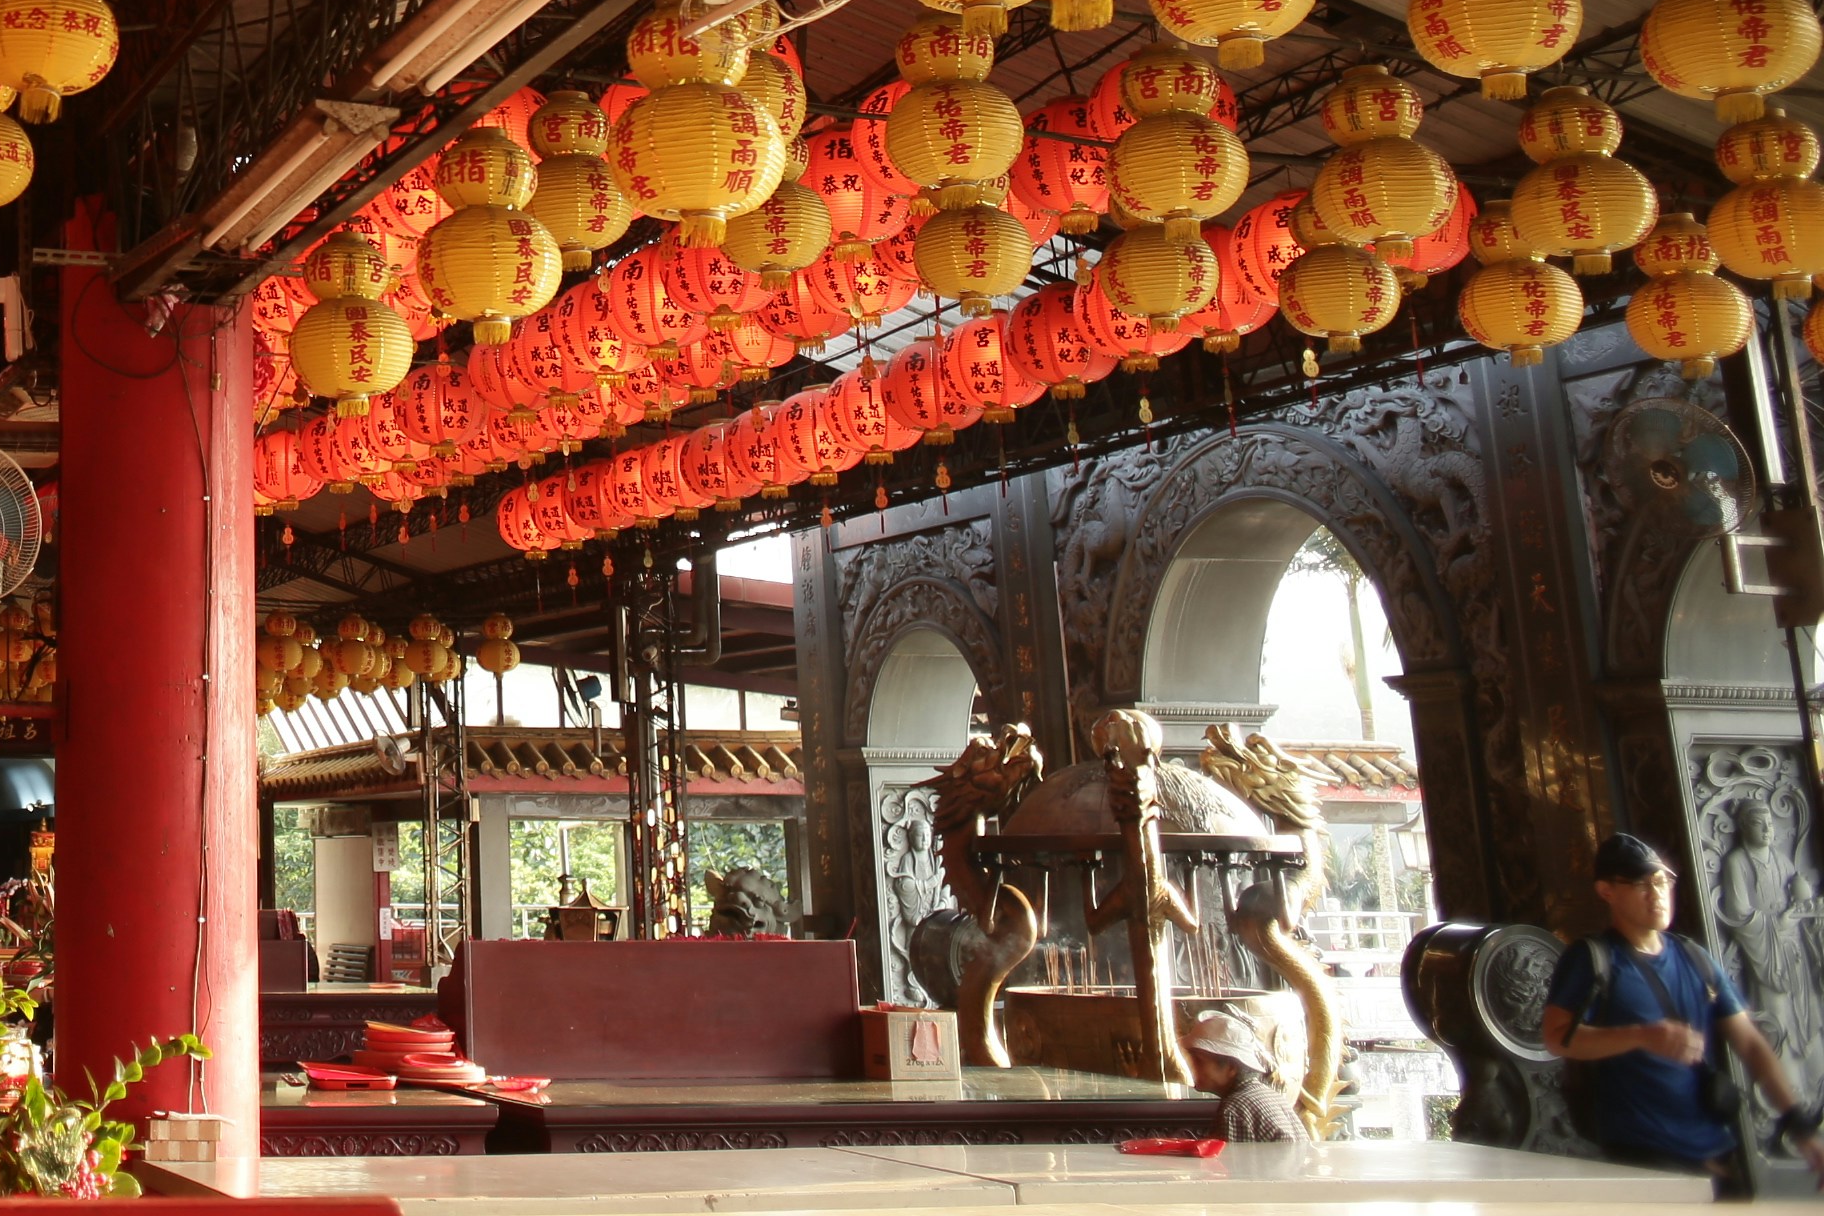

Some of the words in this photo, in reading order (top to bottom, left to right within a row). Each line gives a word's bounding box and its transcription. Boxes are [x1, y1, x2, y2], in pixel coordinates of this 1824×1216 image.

[825, 139, 853, 159] 指
[823, 174, 861, 194] 恭祝
[1071, 167, 1106, 185] 紀念
[395, 196, 432, 216] 紀念
[507, 220, 538, 306] 國泰民安
[622, 260, 643, 282] 南
[854, 260, 887, 278] 成道
[855, 280, 888, 295] 紀念
[345, 306, 374, 383] 國泰民安
[974, 327, 994, 347] 宮
[905, 352, 924, 372] 南
[1059, 348, 1089, 362] 紀念
[970, 361, 1002, 377] 成道
[974, 379, 1004, 394] 紀念
[443, 398, 469, 412] 成道
[854, 406, 882, 419] 成道
[442, 414, 469, 428] 紀念
